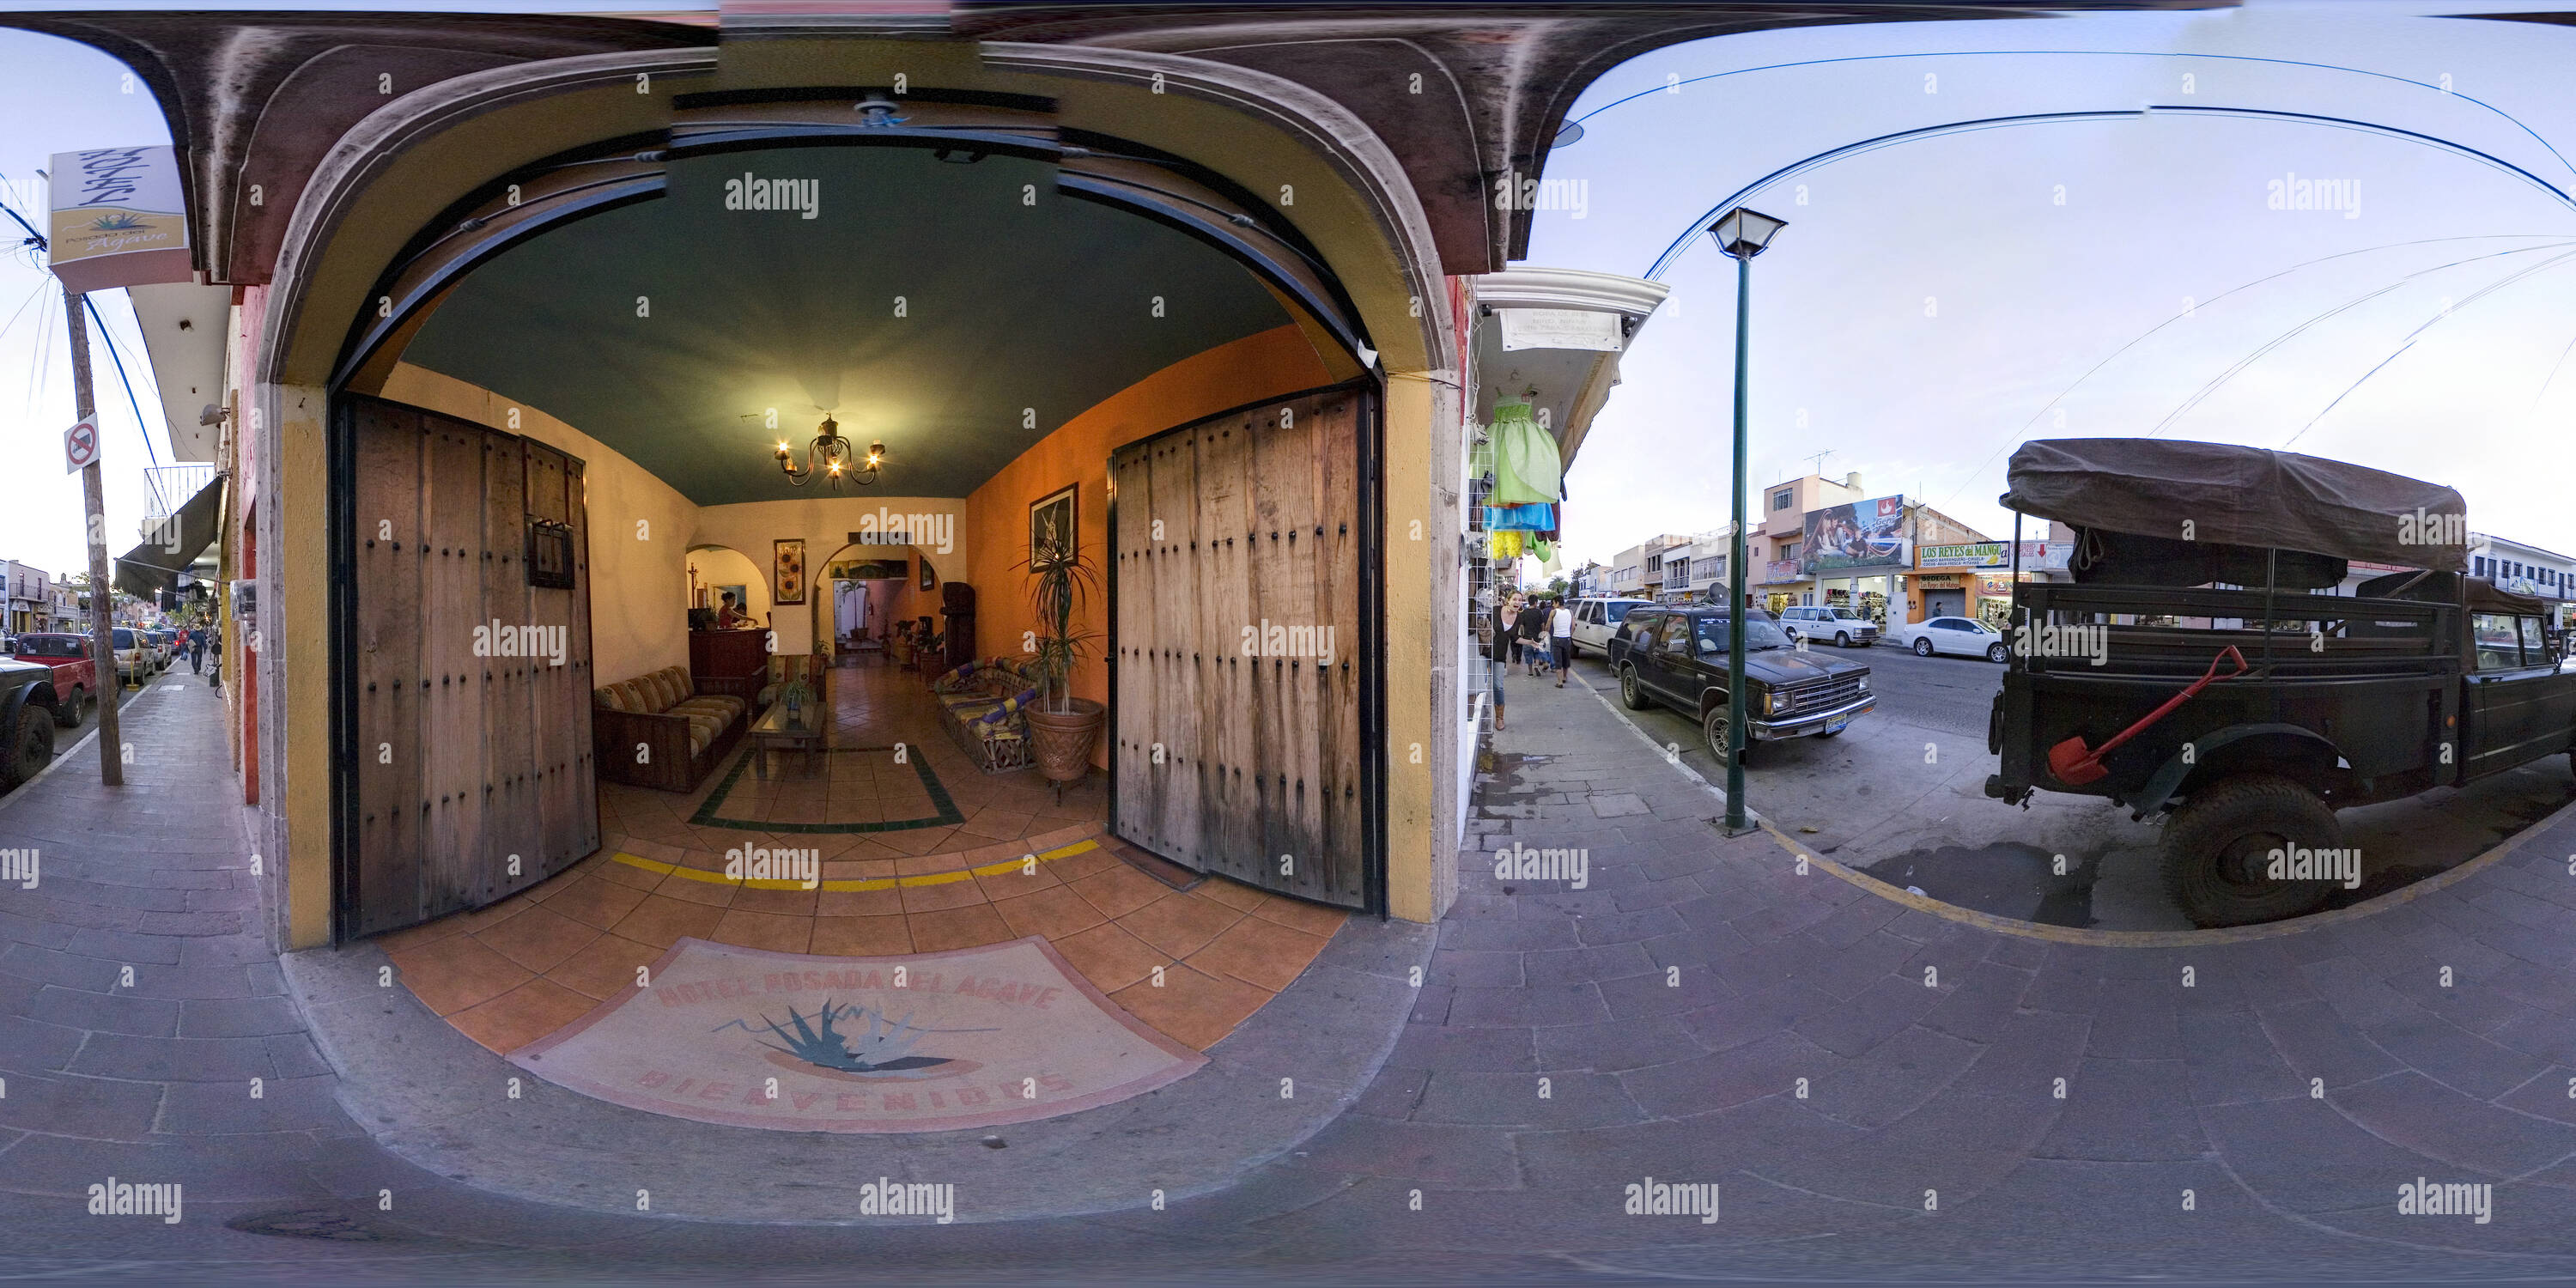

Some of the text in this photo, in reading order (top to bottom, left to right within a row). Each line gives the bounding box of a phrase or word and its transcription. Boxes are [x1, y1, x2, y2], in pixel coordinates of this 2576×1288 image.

[86, 233, 167, 253] Agave
[1922, 548, 1936, 558] LOS
[1939, 545, 1965, 557] REYES
[1975, 544, 2001, 556] MANGO
[656, 979, 753, 1008] HOTEL
[764, 969, 885, 992] POSADA
[955, 975, 1064, 1011] AGAVE
[638, 1069, 1074, 1112] BIENVENIDOS
